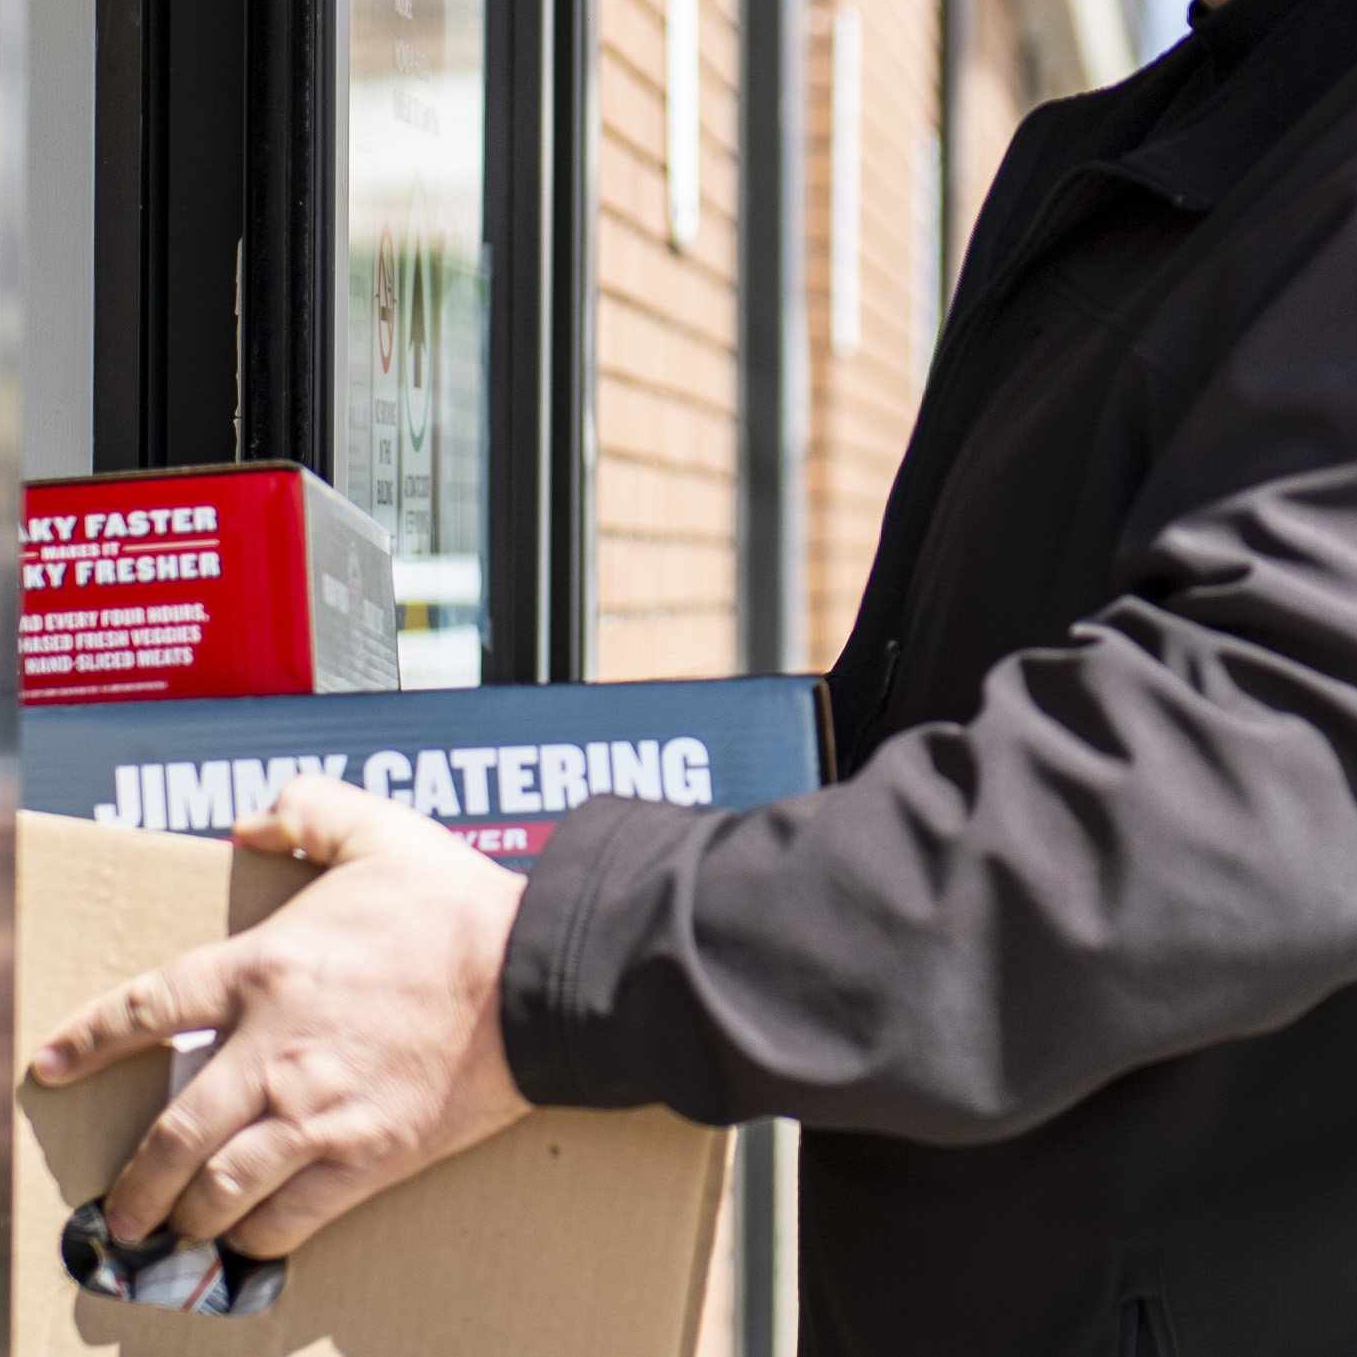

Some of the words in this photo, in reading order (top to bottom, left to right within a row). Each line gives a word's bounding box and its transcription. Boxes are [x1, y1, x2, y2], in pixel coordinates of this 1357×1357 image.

[84, 505, 218, 539] FASTER
[41, 543, 101, 560] MAKES
[101, 541, 121, 557] IT
[75, 551, 221, 587] FRESHER
[44, 610, 99, 632] EVERY
[100, 606, 146, 628] FOUR
[75, 629, 130, 650] FRESH
[130, 624, 202, 647] VEGGIES
[24, 650, 136, 676] HAND-SLICED
[136, 646, 194, 668] MEATS
[363, 736, 713, 817] CATERING
